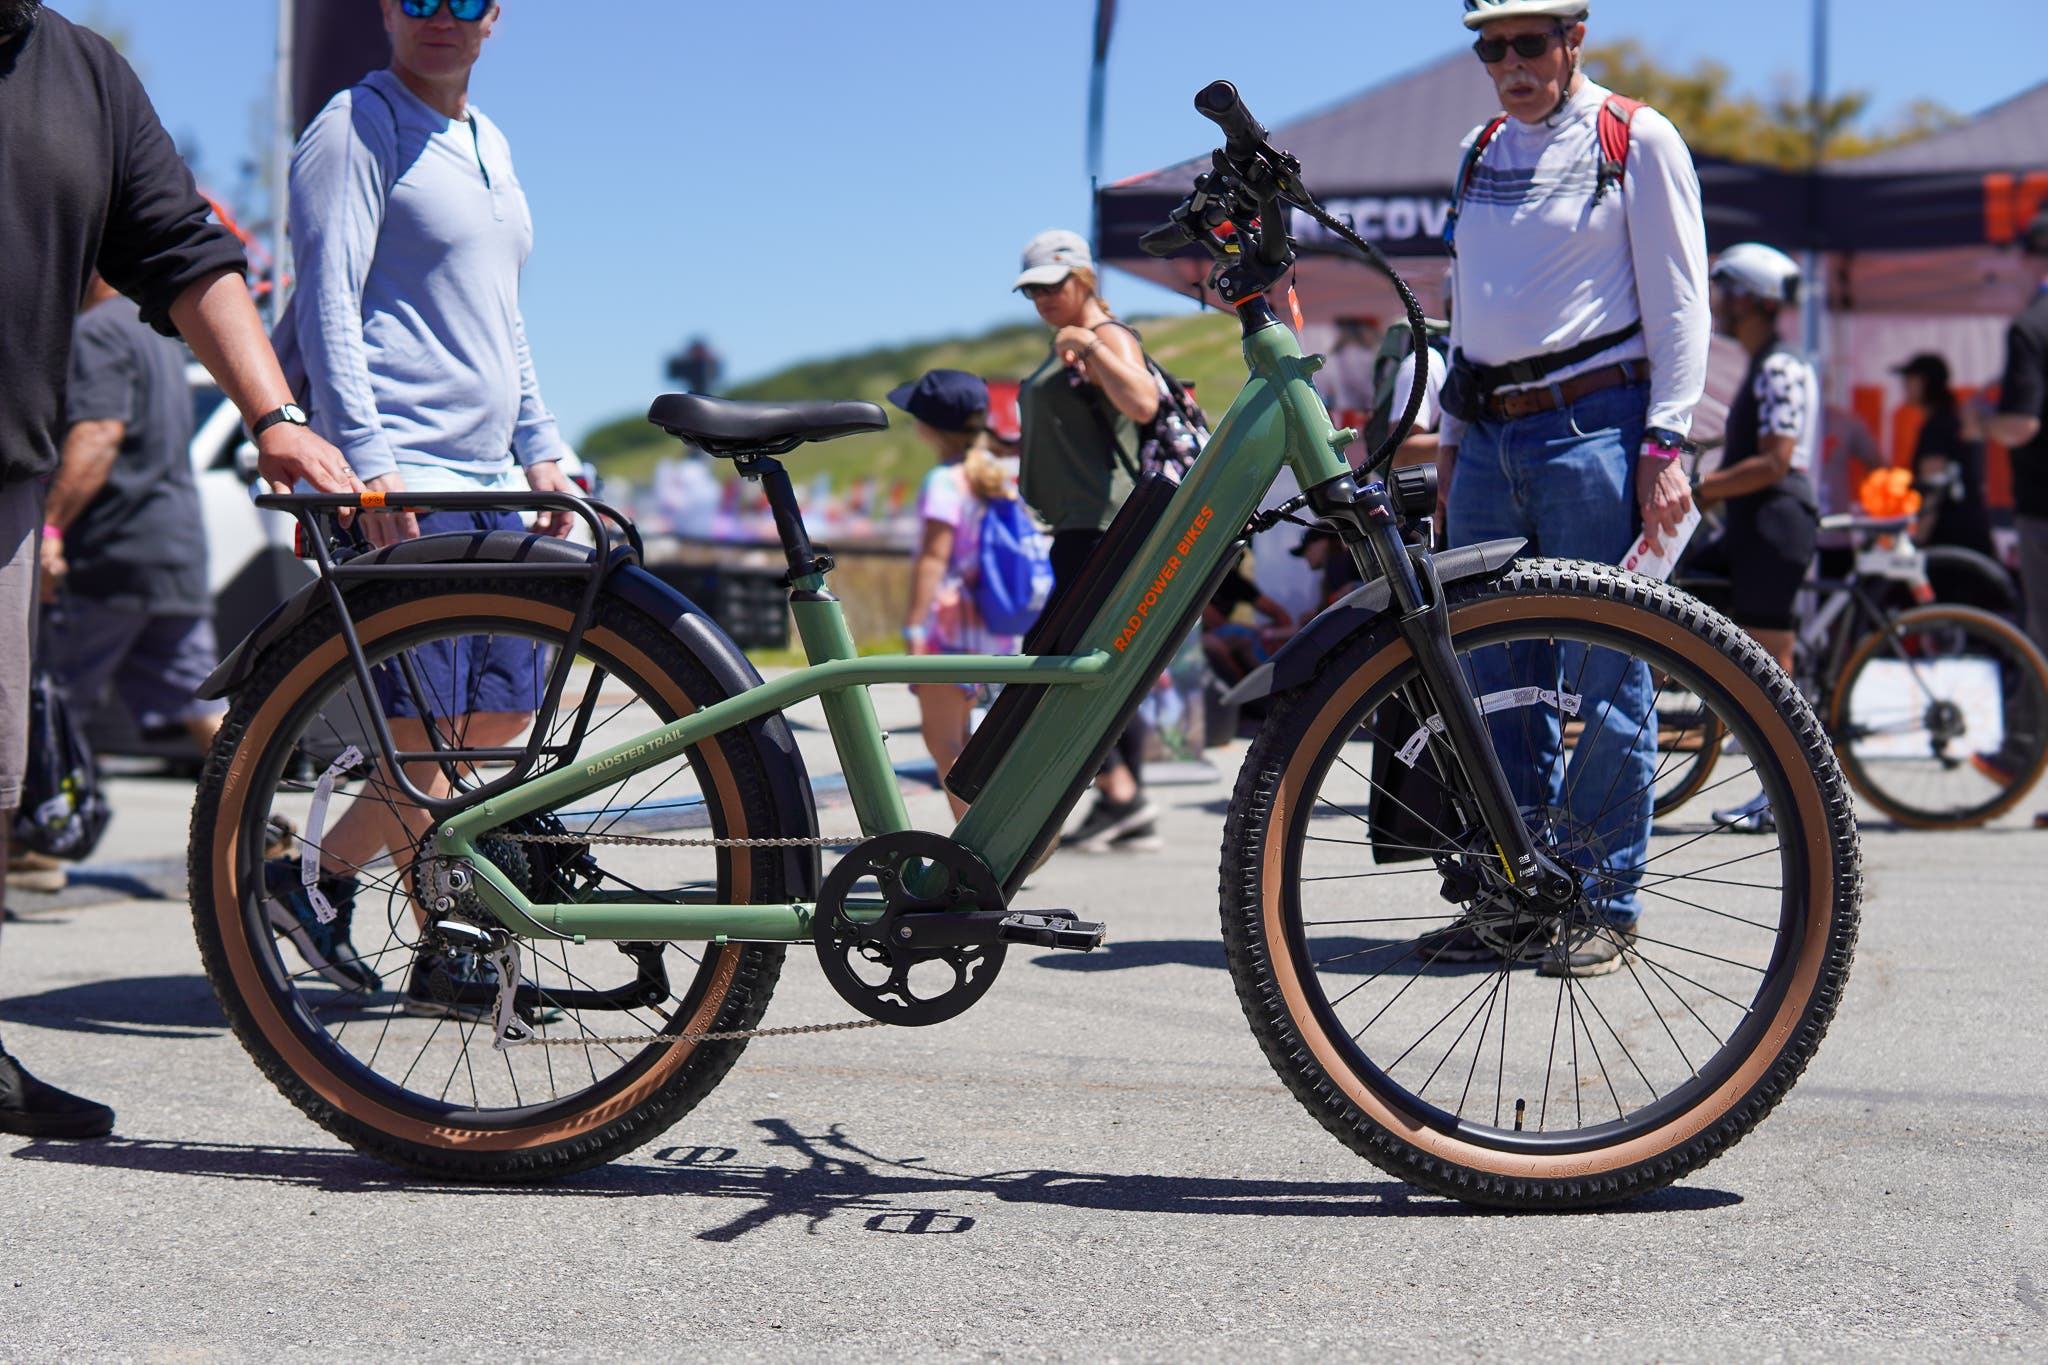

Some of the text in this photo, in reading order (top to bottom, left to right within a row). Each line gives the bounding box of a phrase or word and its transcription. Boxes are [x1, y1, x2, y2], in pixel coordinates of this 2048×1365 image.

[1113, 505, 1214, 652] RAD POWER BIKES
[586, 729, 685, 777] RADSTER TRAIL
